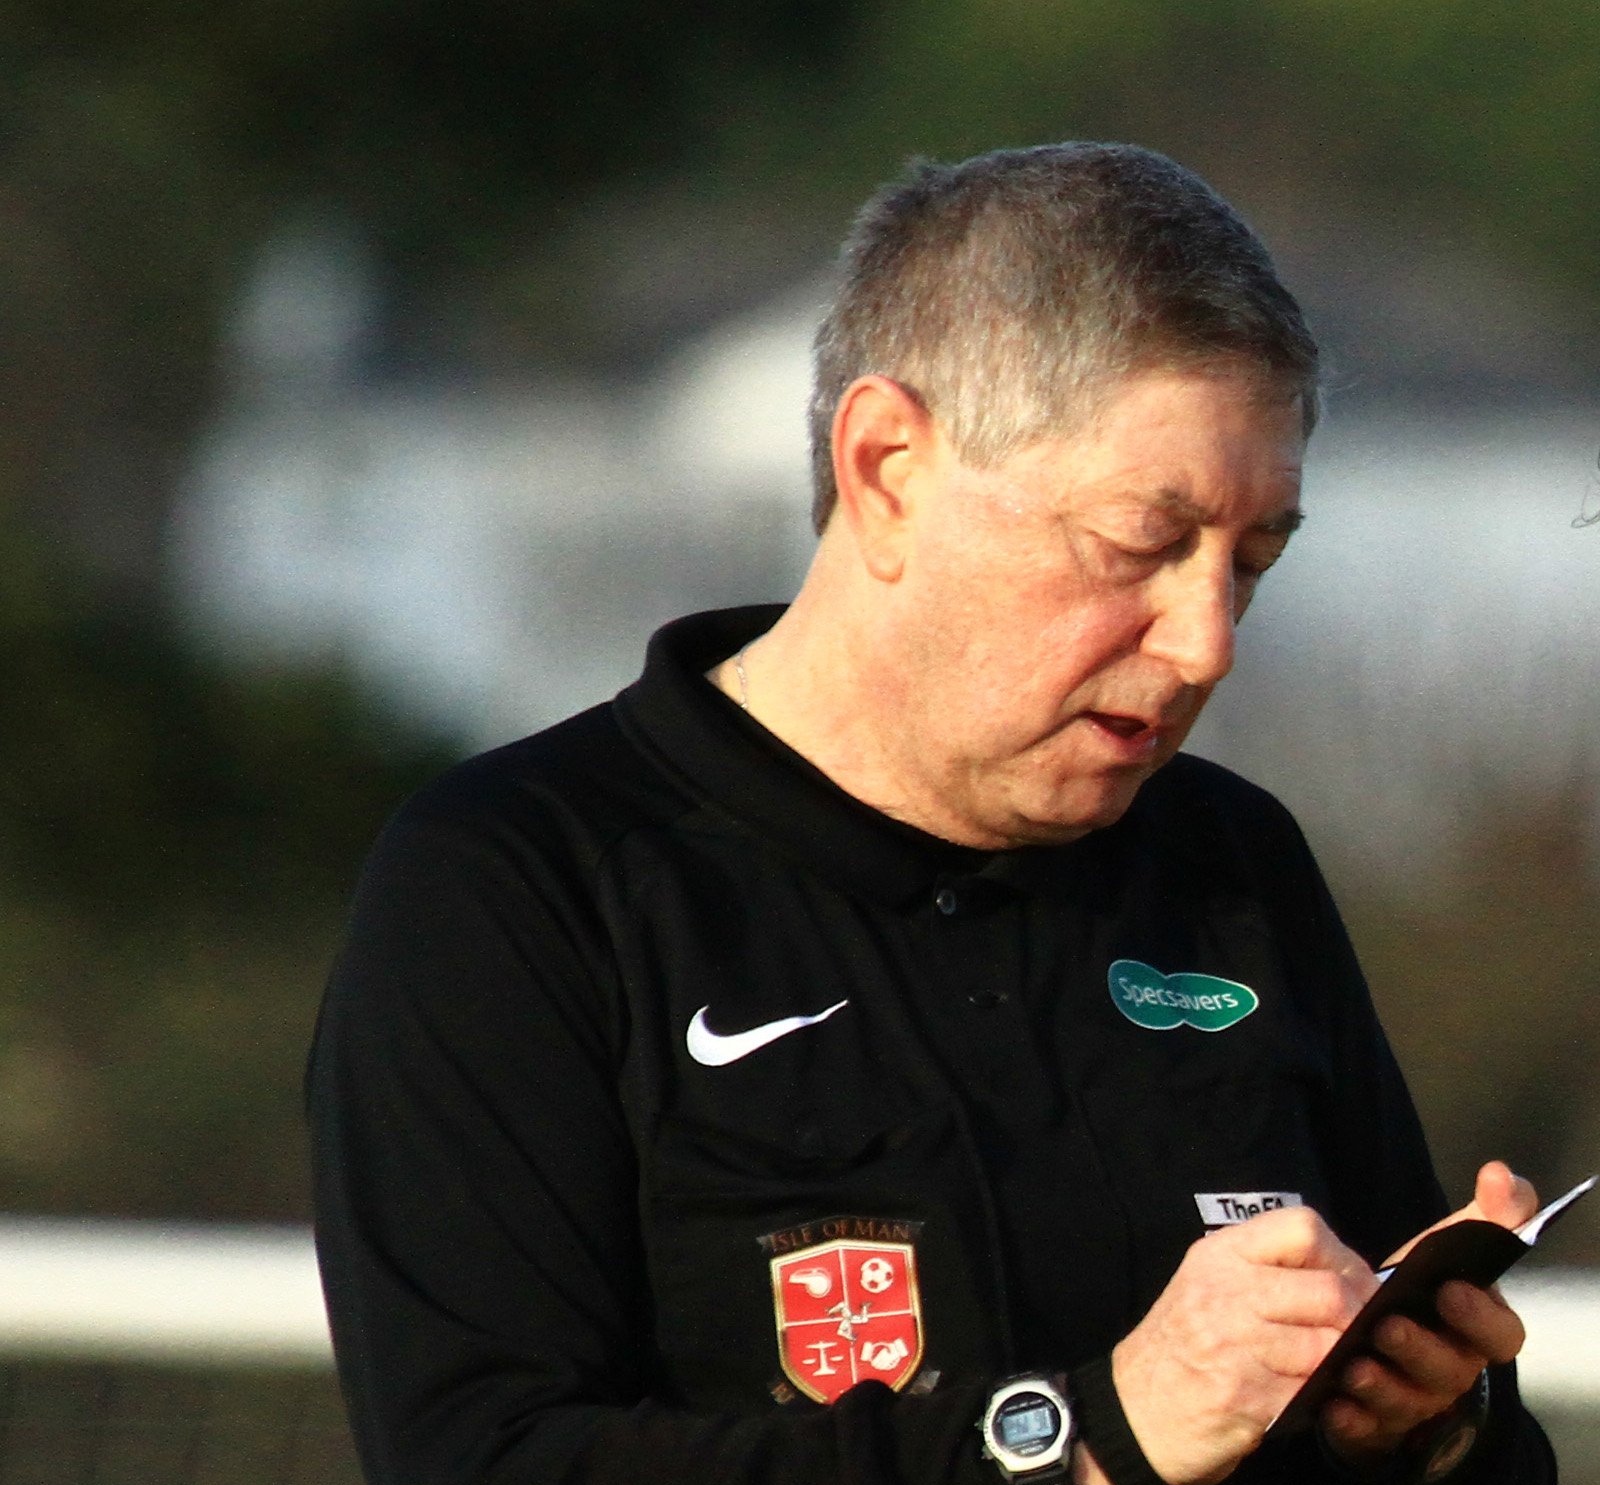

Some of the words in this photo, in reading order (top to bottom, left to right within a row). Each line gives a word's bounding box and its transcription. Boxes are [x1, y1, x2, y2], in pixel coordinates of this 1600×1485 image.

[1118, 977, 1239, 1011] Specsavers
[771, 1226, 813, 1251] ISLE
[855, 1218, 910, 1240] MAN
